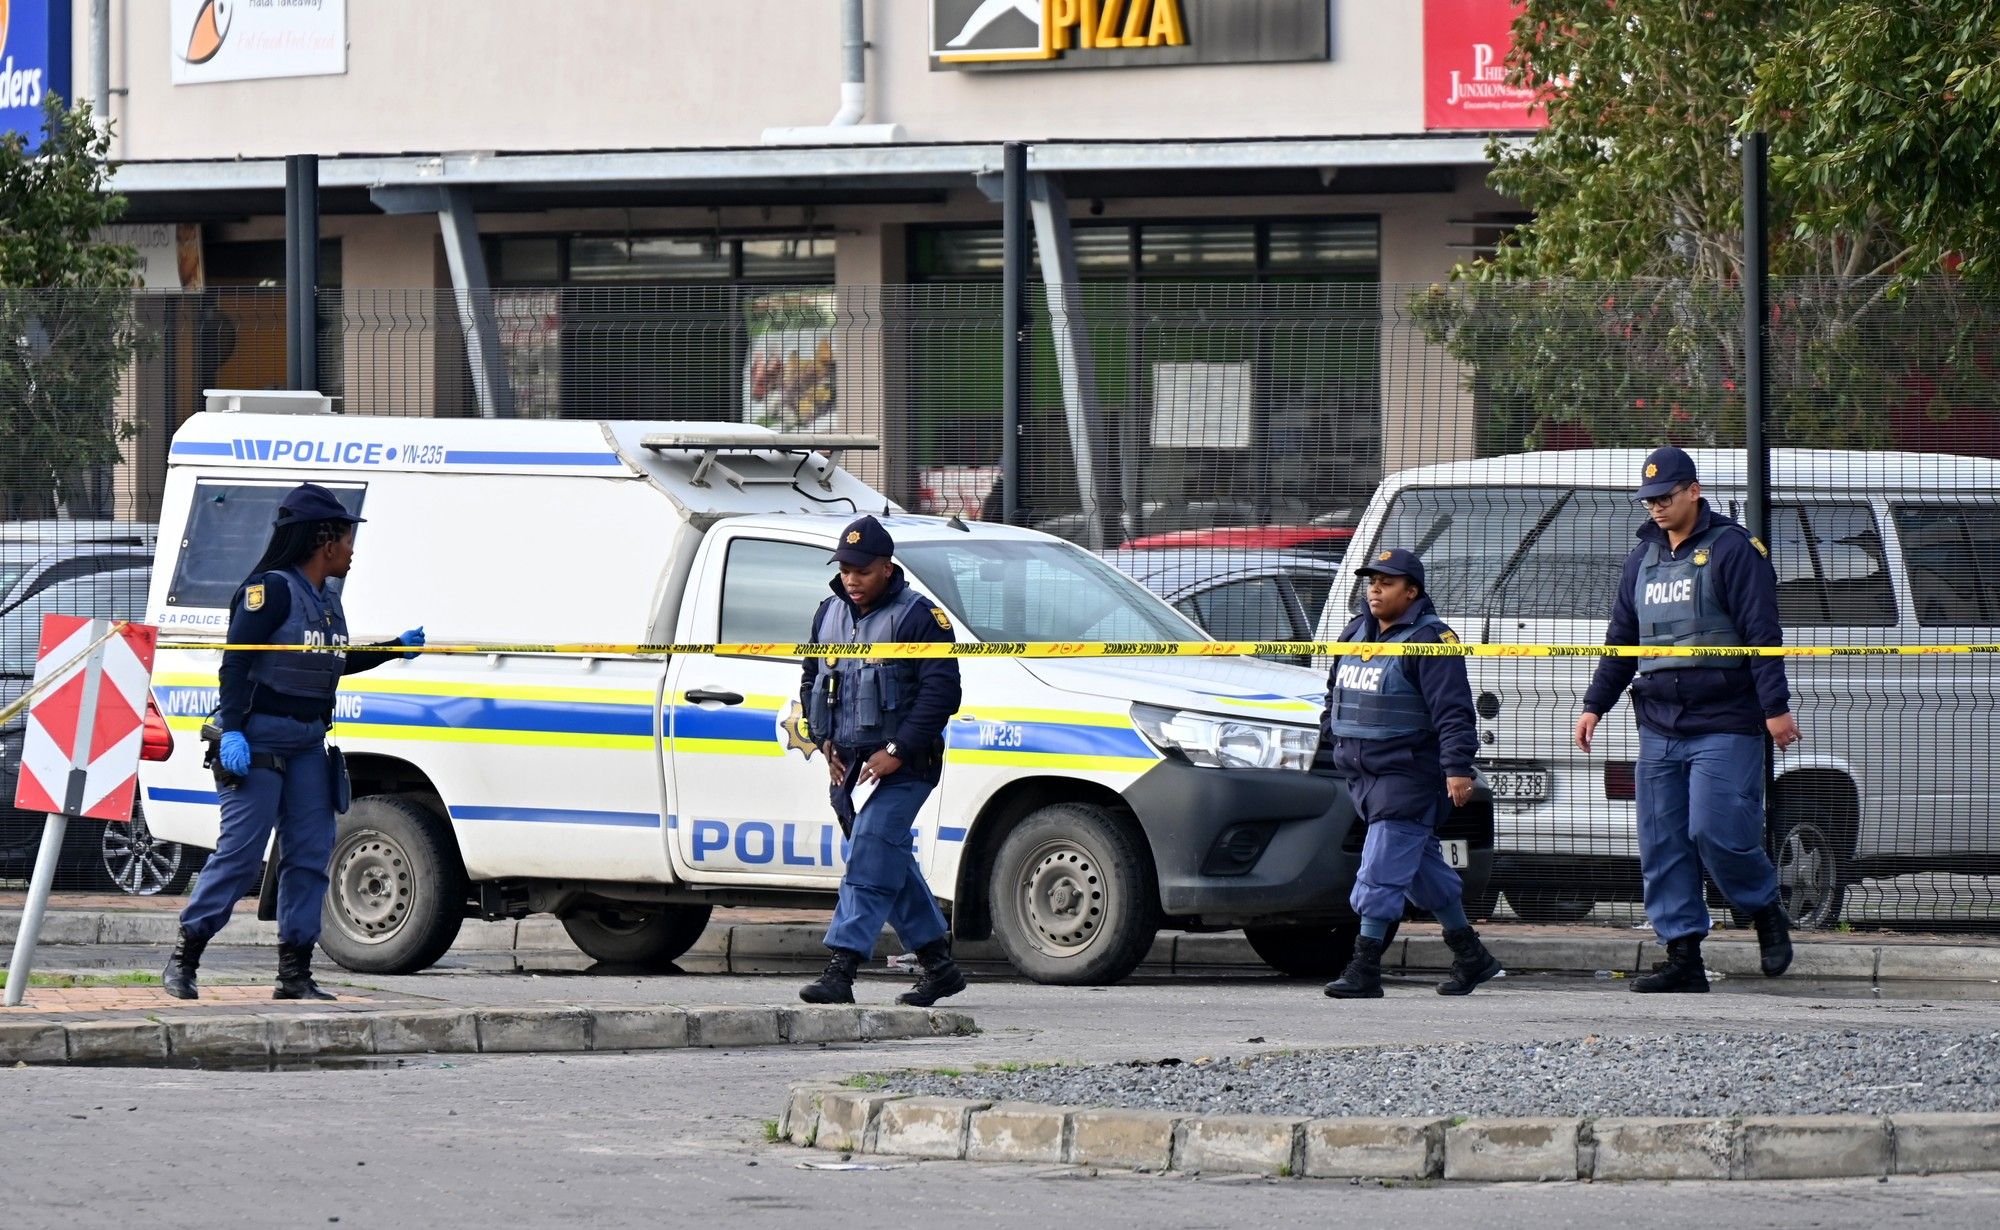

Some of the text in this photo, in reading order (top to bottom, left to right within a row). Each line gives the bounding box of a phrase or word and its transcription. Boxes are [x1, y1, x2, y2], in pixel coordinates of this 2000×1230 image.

[1052, 0, 1185, 49] PIZZA
[1447, 70, 1507, 105] JUNXION
[272, 440, 444, 465] POLICE YN-235
[1645, 578, 1691, 605] POLICE
[180, 614, 221, 625] POLICE
[303, 630, 347, 659] POLCE
[793, 643, 830, 655] SERVICE
[829, 643, 860, 654] POLICE
[948, 643, 985, 654] SERVICE
[984, 643, 1014, 654] POLICE
[1101, 643, 1138, 654] SERVICE
[1136, 643, 1167, 654] POLICE
[1287, 643, 1316, 654] POLICE
[1335, 664, 1383, 691] POLICE
[332, 694, 362, 719] ING
[979, 724, 1022, 747] YN-235
[692, 819, 920, 868] POLI
